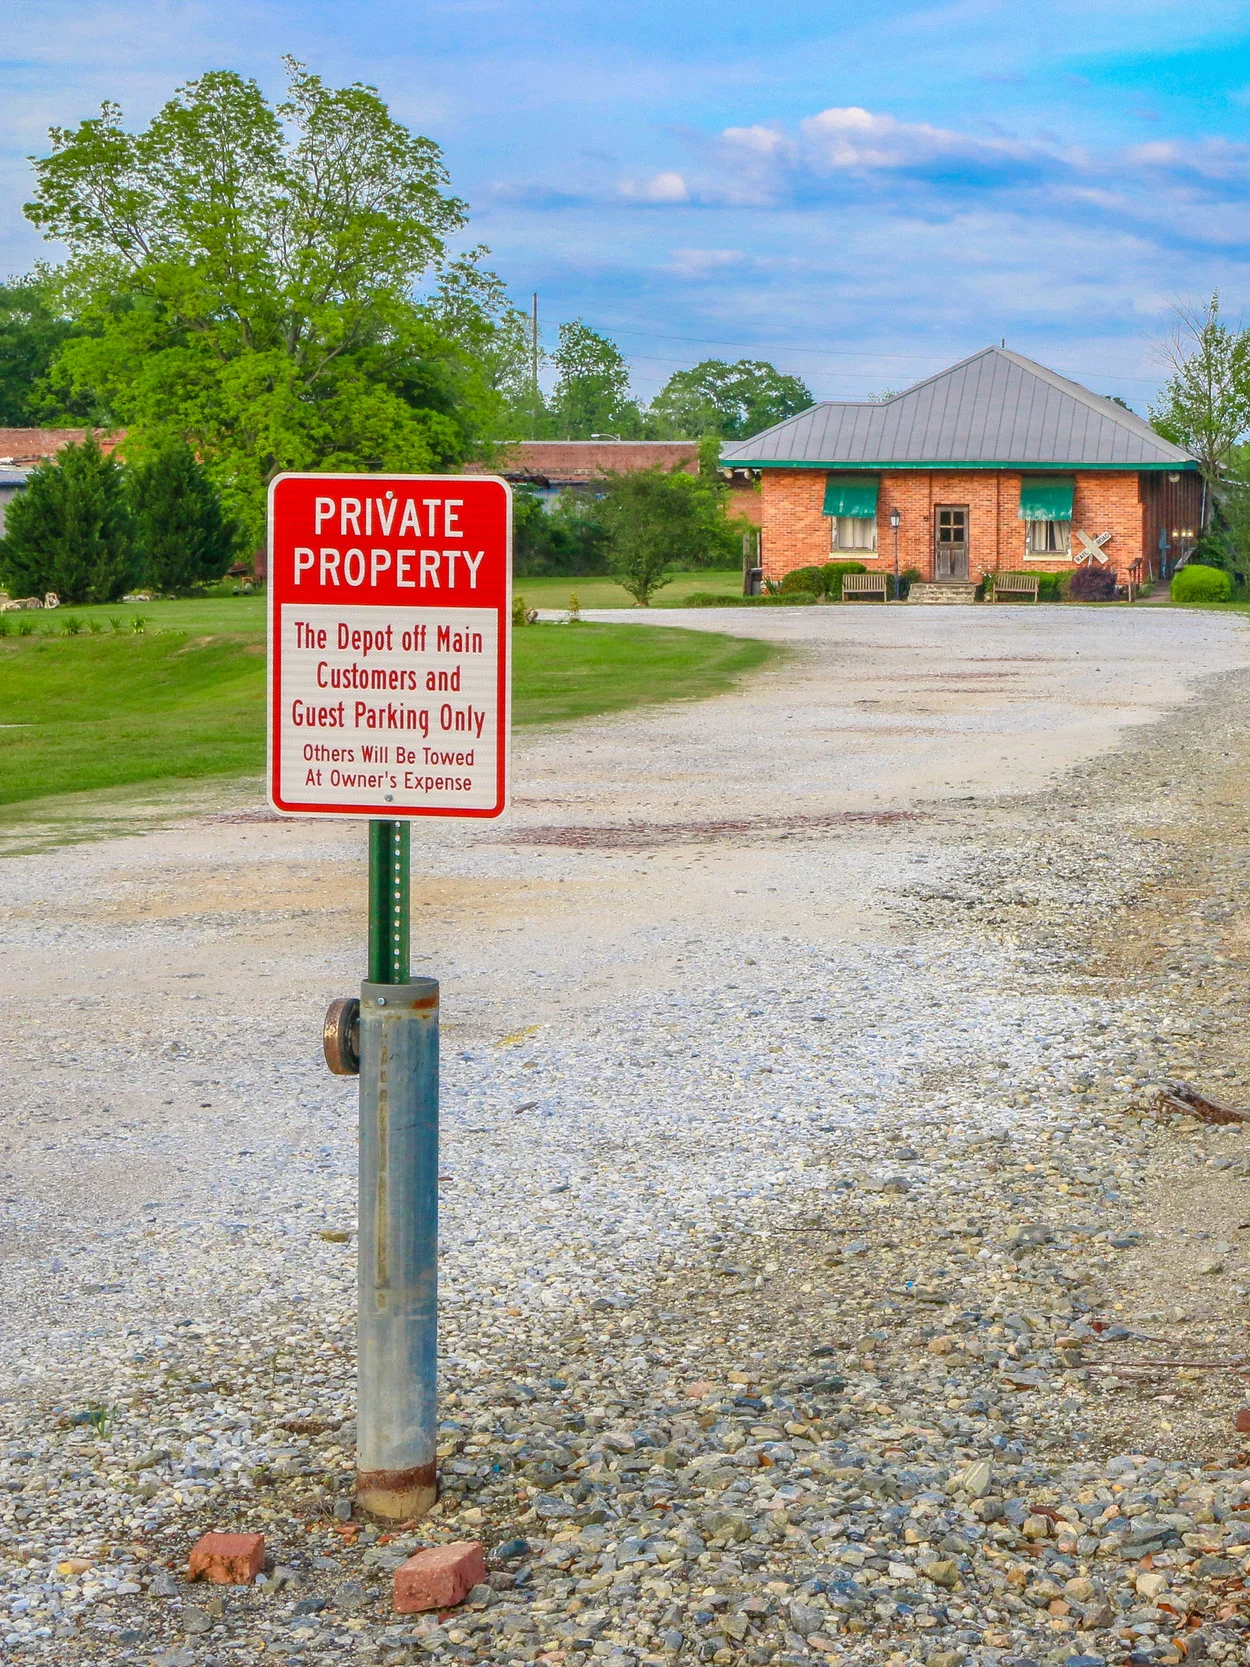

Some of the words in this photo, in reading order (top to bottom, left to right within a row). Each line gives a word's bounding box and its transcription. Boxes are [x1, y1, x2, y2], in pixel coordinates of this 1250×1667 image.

[314, 497, 464, 538] PRIVATE
[293, 547, 485, 590] PROPERTY
[294, 621, 327, 650] The
[337, 622, 393, 657] Depot
[402, 624, 427, 652] off
[436, 625, 483, 653] Main
[317, 661, 417, 691] Customers
[426, 665, 461, 692] and
[292, 700, 345, 728] Guest
[355, 701, 429, 739] Parking
[440, 703, 486, 739] Only
[303, 743, 355, 763] Others
[361, 745, 389, 764] Will
[396, 746, 416, 765] Be
[423, 747, 475, 766] Towed
[305, 769, 322, 787] At
[330, 769, 397, 789] Owner's
[404, 772, 472, 793] Expense
